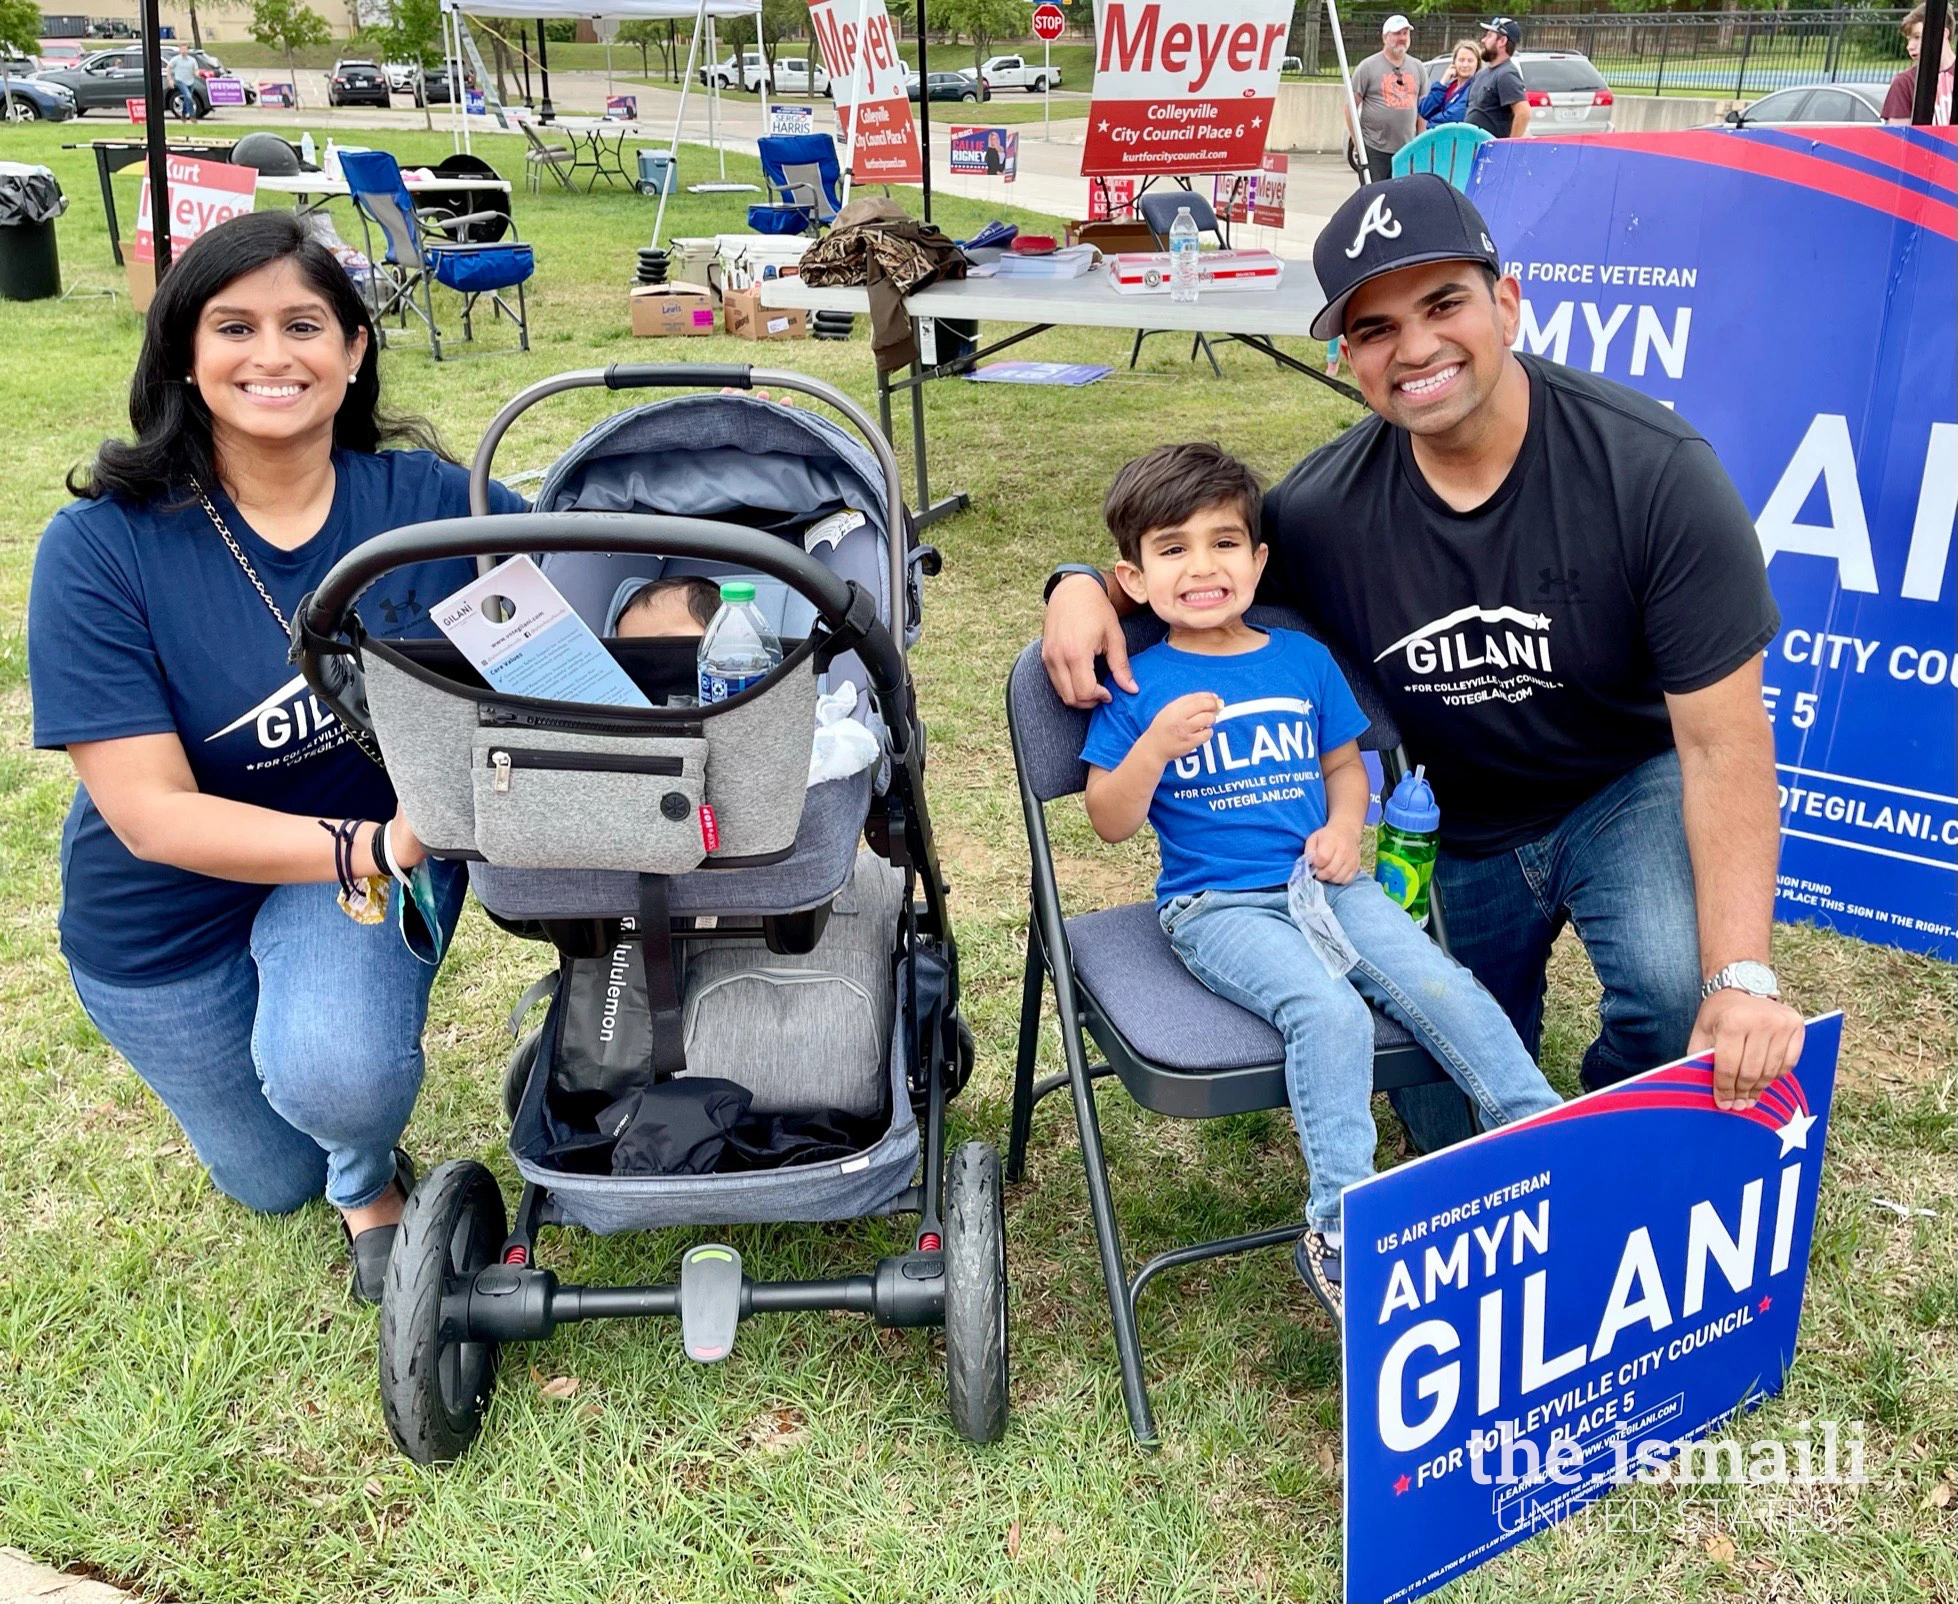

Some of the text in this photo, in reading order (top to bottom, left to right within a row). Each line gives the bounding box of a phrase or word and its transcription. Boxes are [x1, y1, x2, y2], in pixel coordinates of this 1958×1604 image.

[1035, 15, 1062, 30] STOP
[812, 8, 893, 95] Meyer
[1100, 3, 1287, 93] Meyer
[772, 122, 810, 134] HARRIS
[1147, 104, 1218, 122] Colleyville
[1111, 124, 1245, 145] City Council Place 6
[952, 150, 987, 162] RIGNEY
[1122, 150, 1227, 164] kurtforcitycouncil.com
[1345, 193, 1402, 259] A
[1528, 263, 1595, 283] FORCE
[1600, 265, 1698, 288] VETERAN
[1510, 299, 1693, 380] MYN
[443, 600, 473, 627] GILANI
[489, 652, 523, 676] Core Values
[1406, 631, 1552, 674] GILANI
[1783, 629, 1881, 673] CITY
[1411, 684, 1432, 692] FOR
[1434, 675, 1498, 692] COLLEYVILLE
[1792, 691, 1819, 729] 5
[257, 757, 280, 770] FOR
[1174, 721, 1315, 779] GILANI
[1181, 789, 1199, 799] FOR
[1200, 776, 1267, 797] COLLEYVILLE
[1269, 773, 1291, 785] CITY
[1801, 879, 1832, 895] FUND
[1783, 888, 1819, 906] PLACE
[1820, 896, 1845, 912] THIS
[1847, 903, 1874, 919] SIGN
[1876, 911, 1889, 922] IN
[1891, 914, 1914, 928] THE
[600, 944, 632, 1041] lululemon
[1376, 1170, 1551, 1255] US AIR FORCE VETERAN
[1379, 1199, 1550, 1325] AMYN
[1378, 1162, 1802, 1453] GILANI
[1417, 1304, 1755, 1489] FOR COLLEYVILLE CITY COUNCIL
[1549, 1390, 1636, 1451] PLACE 5
[1499, 1480, 1533, 1503] LEARN
[1575, 1401, 1678, 1462] WWW.VOTEGILANI.COM
[1427, 1560, 1458, 1581] VIOLATION
[1466, 1544, 1486, 1559] STATE
[1485, 1537, 1499, 1548] LAW
